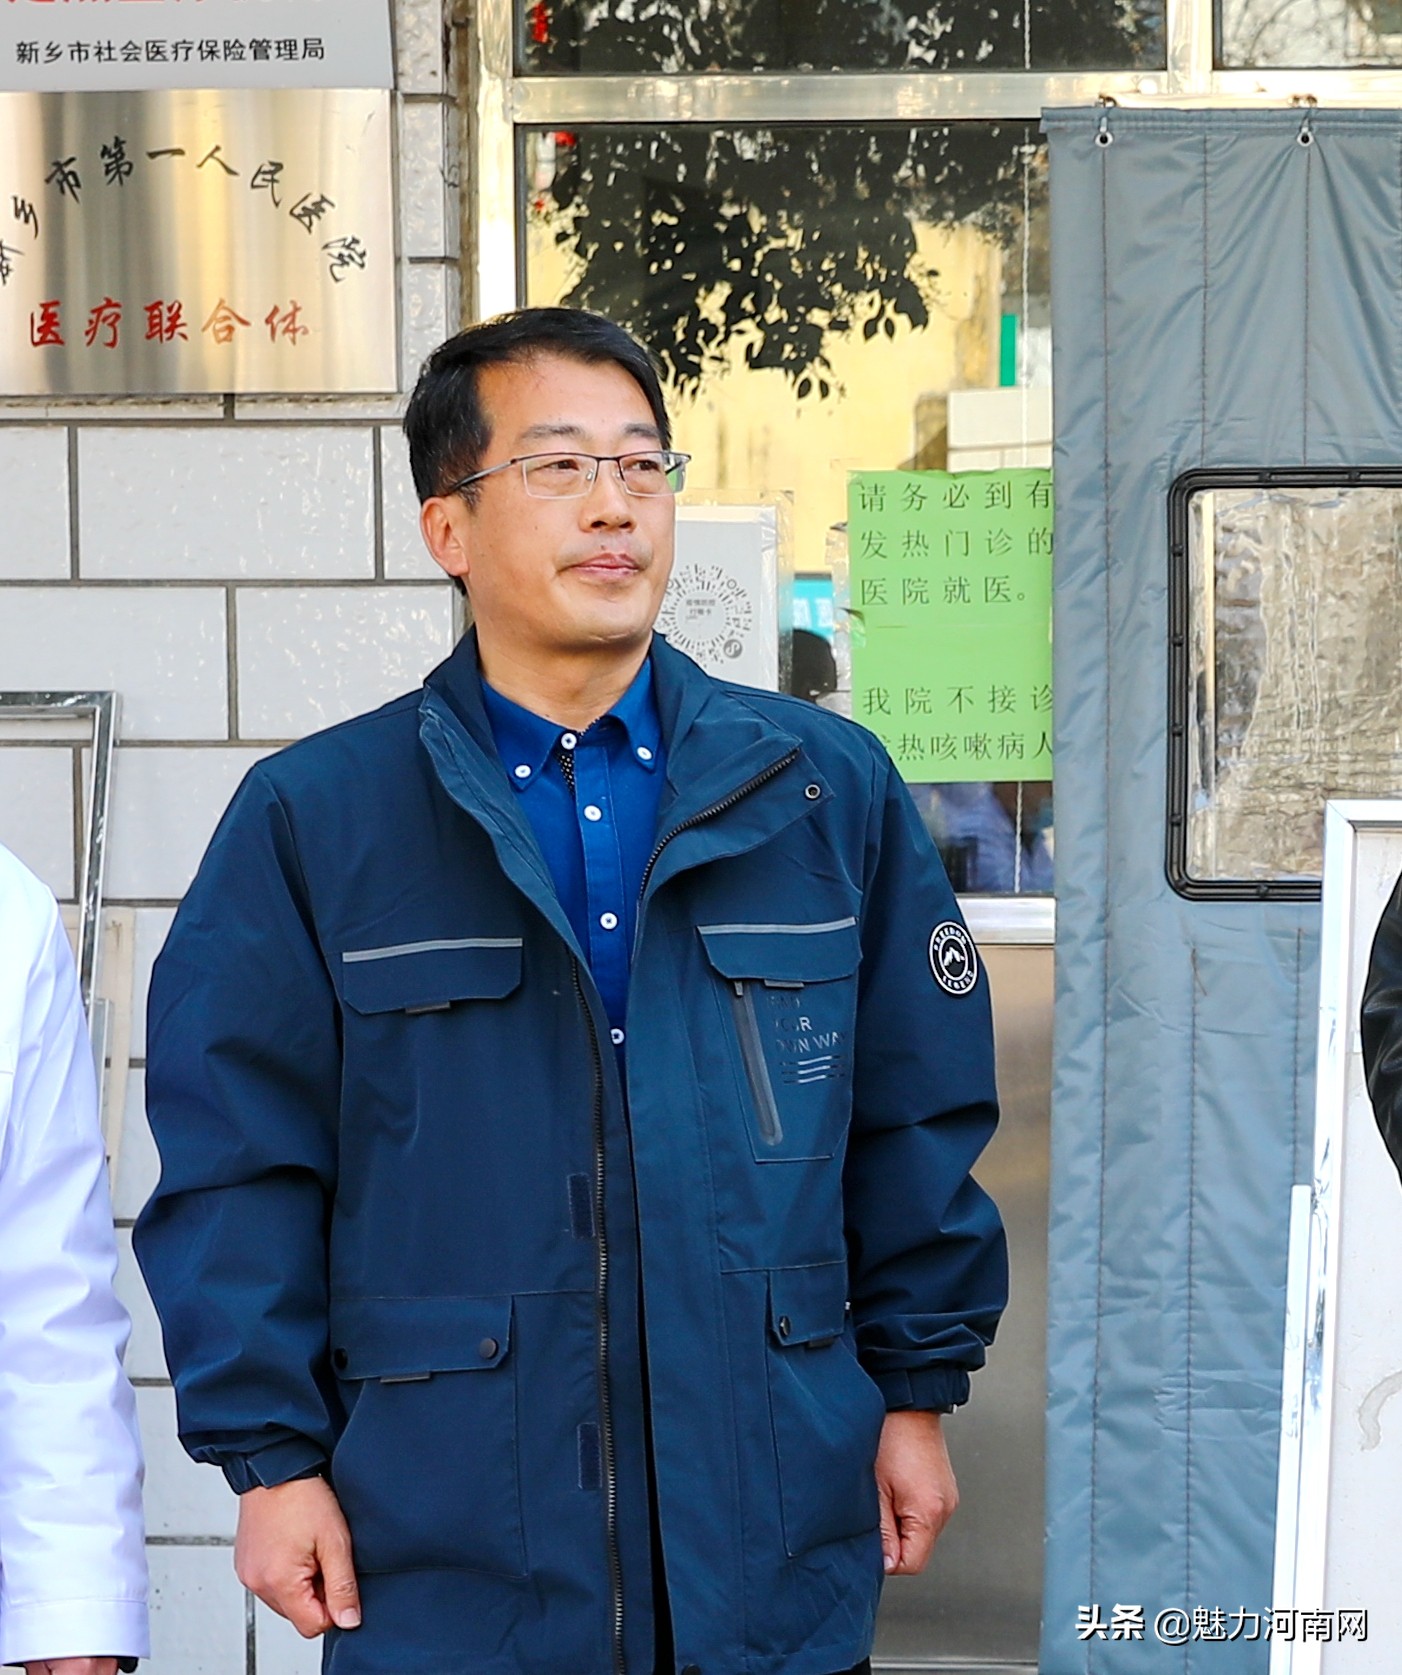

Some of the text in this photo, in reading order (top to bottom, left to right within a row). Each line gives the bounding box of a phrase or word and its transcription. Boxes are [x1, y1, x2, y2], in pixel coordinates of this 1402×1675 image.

[15, 37, 326, 65] 新乡市社会医疗保险管理局
[29, 296, 310, 348] 医疗联合体
[858, 479, 1053, 514] 请务必到有
[859, 526, 1053, 560] 发热门诊的
[859, 573, 1027, 607] 医院就医。
[862, 683, 1053, 717] 我院不接诊
[881, 730, 1053, 762] 热咳嗽病人
